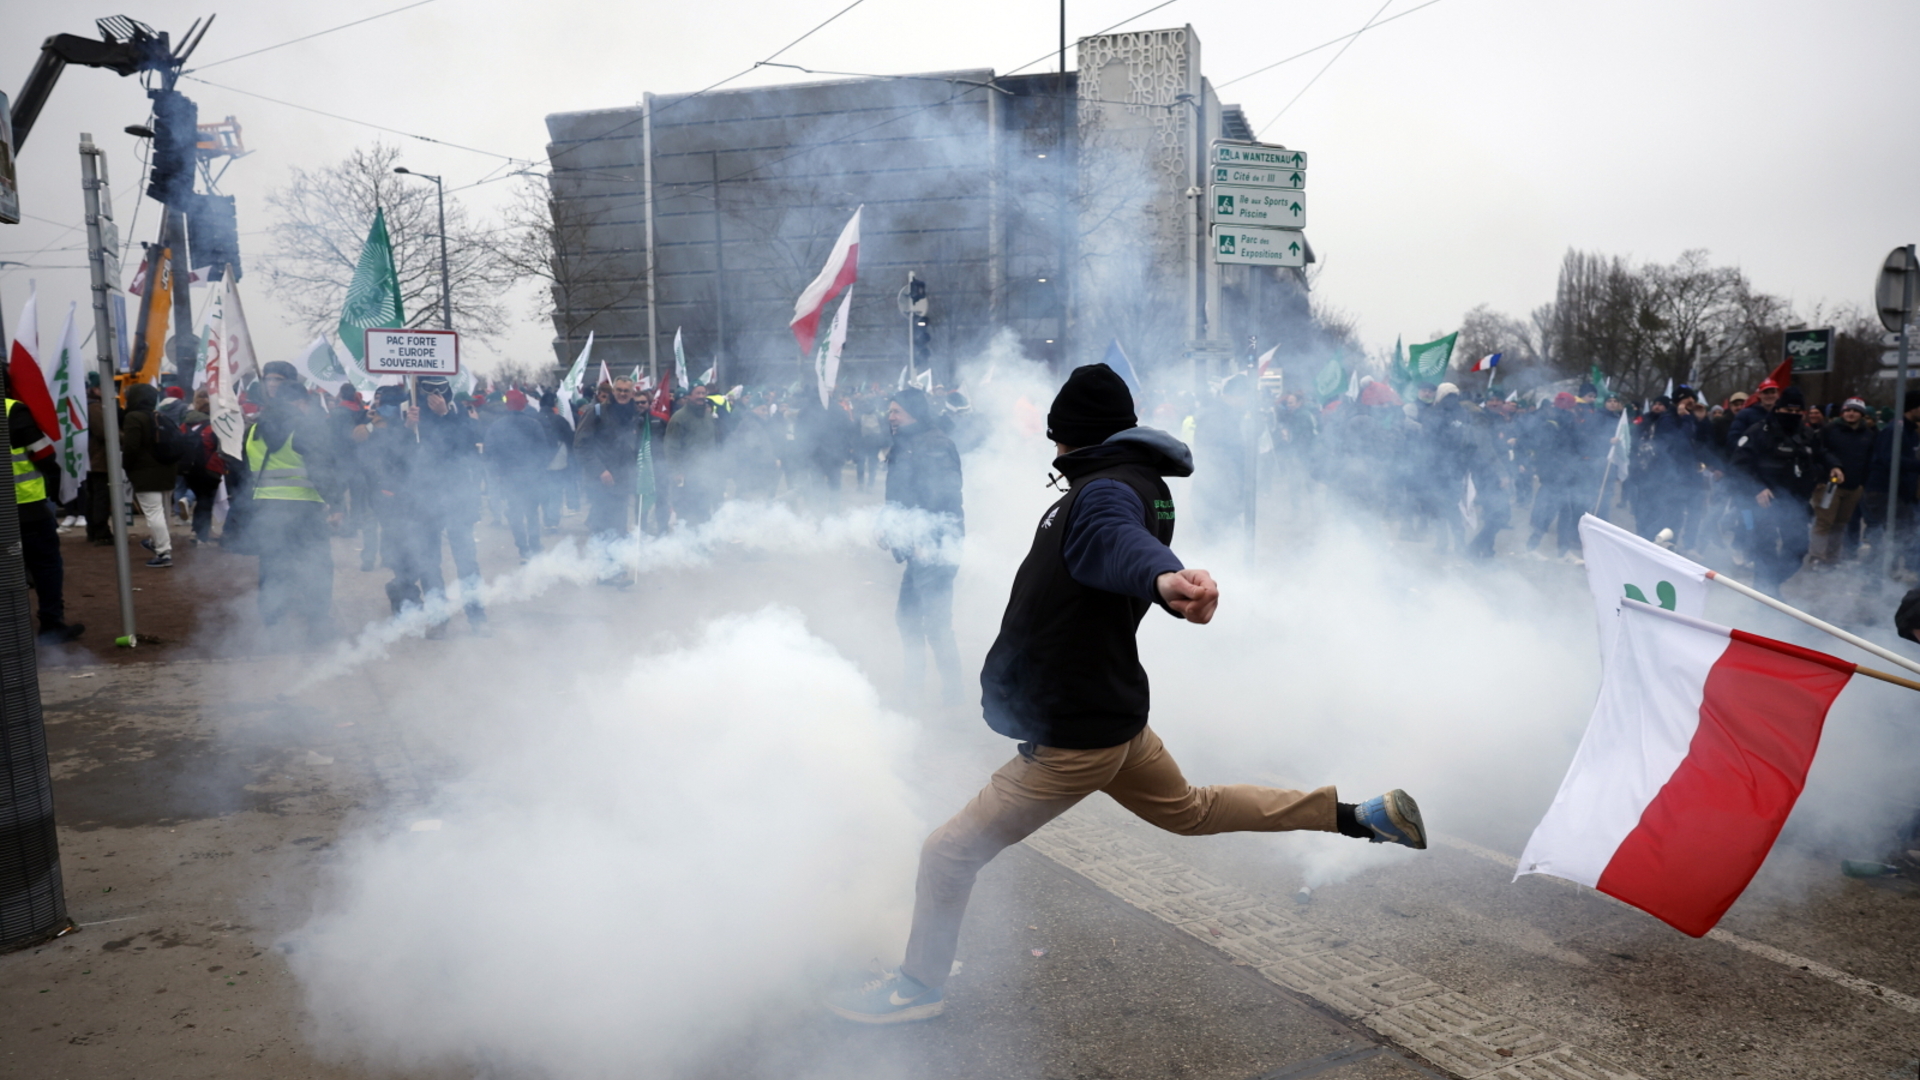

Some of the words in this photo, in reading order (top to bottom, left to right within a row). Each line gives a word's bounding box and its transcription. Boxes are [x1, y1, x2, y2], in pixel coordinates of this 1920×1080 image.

[1230, 150, 1240, 160] LA
[1242, 151, 1291, 164] WANTZENAU
[1233, 171, 1250, 181] Cité
[1252, 174, 1260, 182] de
[1264, 195, 1288, 207] Sports
[1239, 208, 1267, 219] Piscine
[1241, 234, 1258, 244] Parc
[1259, 237, 1269, 245] des
[1241, 248, 1283, 259] Expositions
[386, 335, 404, 346] PAC
[407, 336, 437, 347] FORTE
[398, 347, 436, 358] EUROPE
[380, 357, 439, 369] SOUVERAINE
